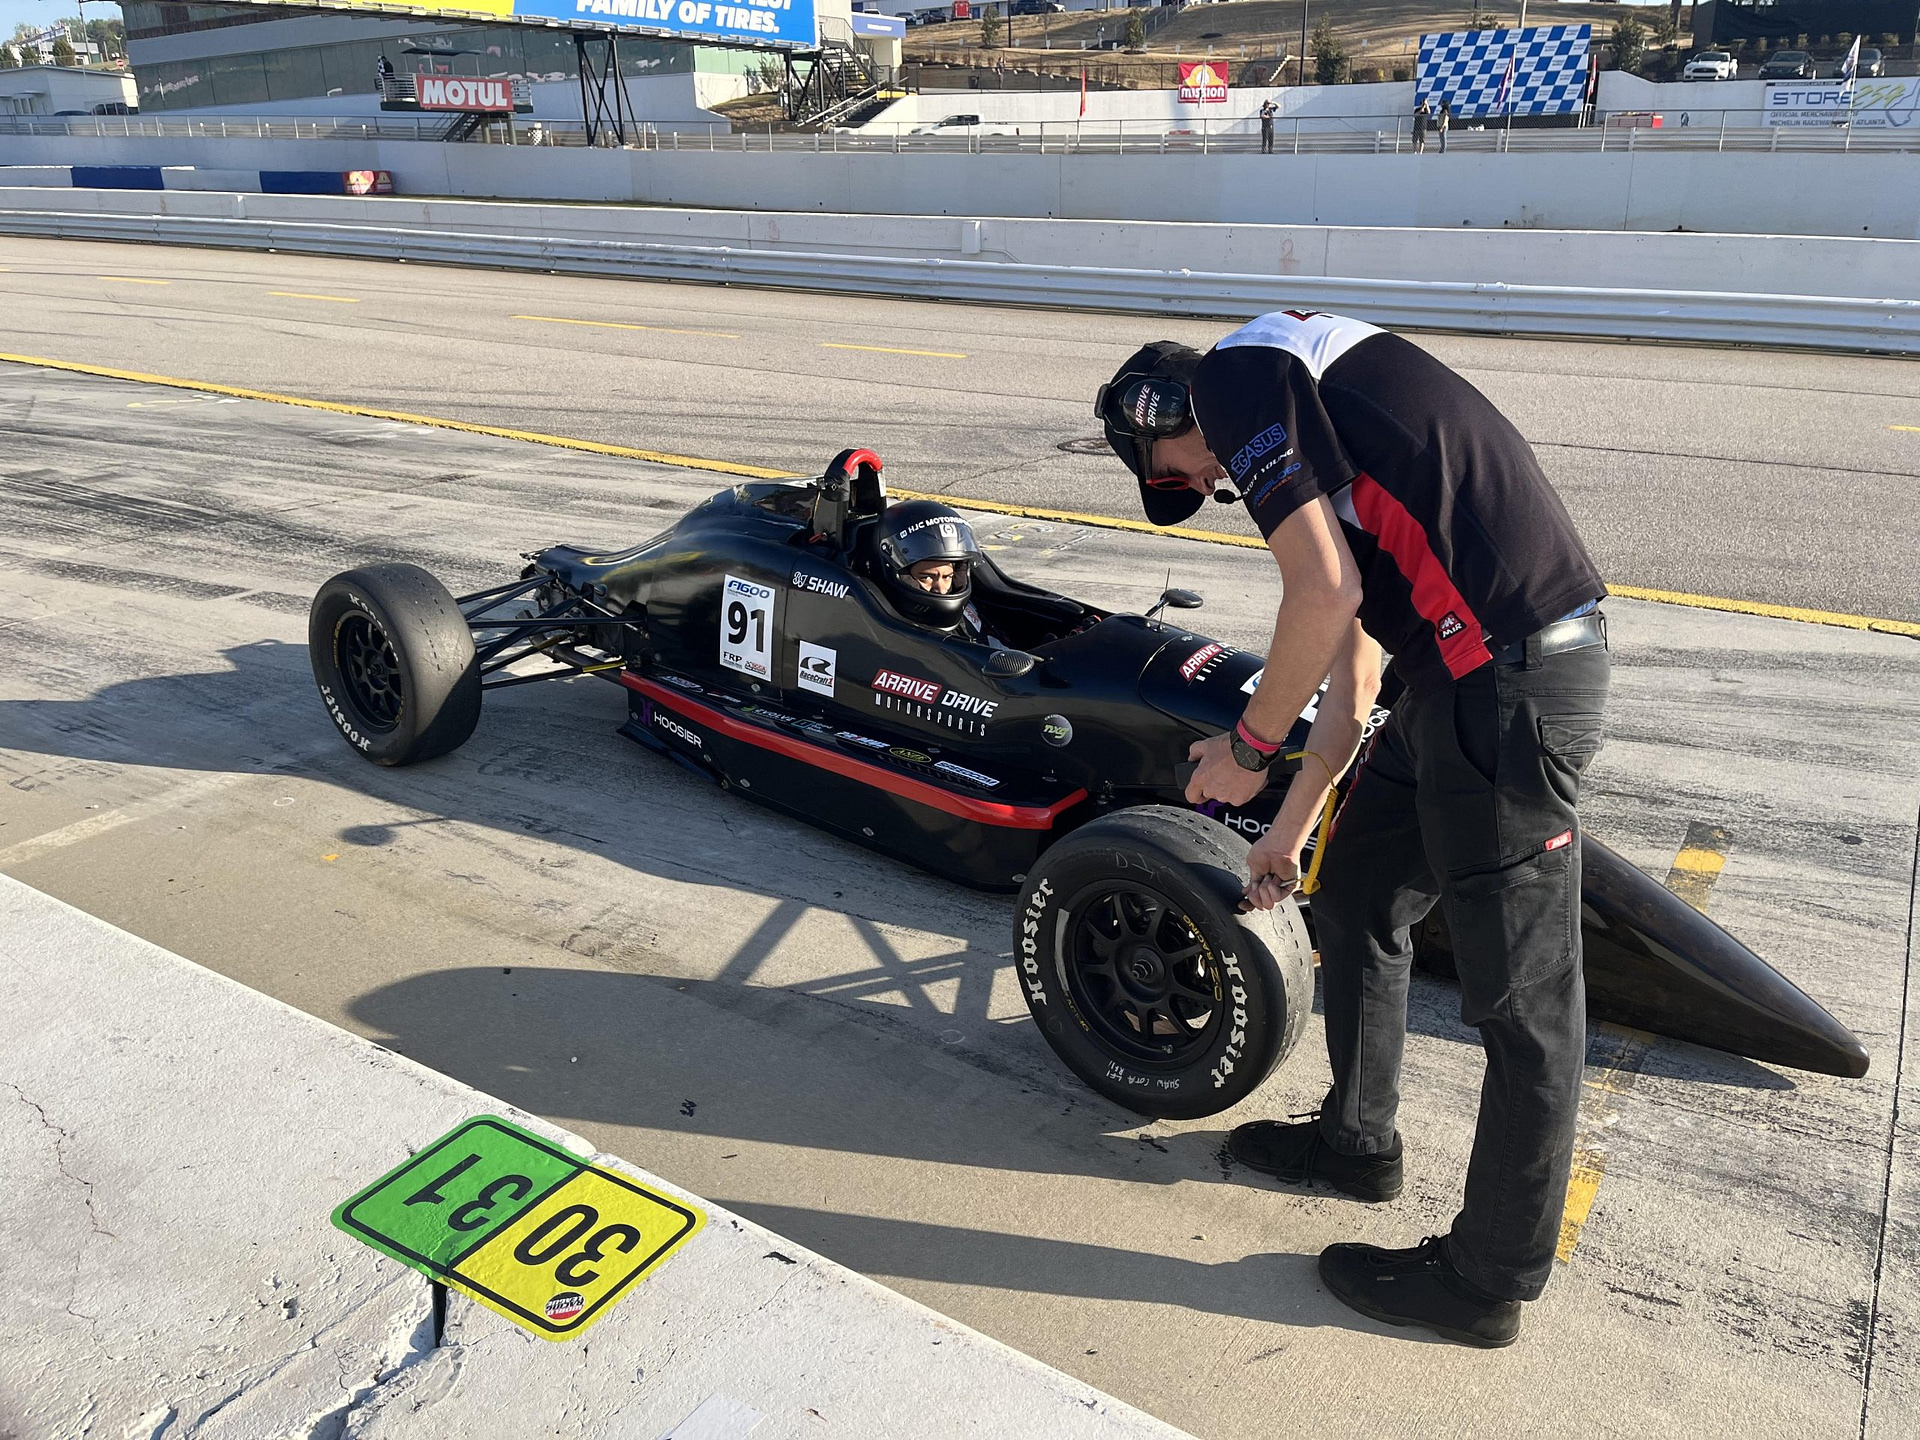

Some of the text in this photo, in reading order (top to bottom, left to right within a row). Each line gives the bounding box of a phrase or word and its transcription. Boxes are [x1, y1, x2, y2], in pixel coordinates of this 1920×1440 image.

[576, 0, 674, 20] FAMILY
[679, 4, 711, 25] OF
[715, 5, 780, 33] TIRES.
[423, 79, 507, 107] MOTUL
[1773, 92, 1857, 105] STORE
[1135, 384, 1151, 427] ARRIVE
[1147, 391, 1160, 427] DRIVE
[1231, 426, 1283, 476] EGASUS
[908, 520, 926, 534] HJC
[807, 576, 849, 599] SHAW
[727, 600, 766, 653] 91
[723, 651, 743, 662] FRP
[1182, 643, 1220, 679] ARRIVE
[874, 671, 999, 718] ARRIVE DRIVE
[875, 692, 986, 737] MOTORSPORTS
[654, 711, 703, 749] HOOSIER
[1021, 877, 1054, 1006] Hoosier
[1210, 949, 1249, 1089] Hoosier
[402, 1153, 534, 1232] 31
[513, 1204, 641, 1287] 30
